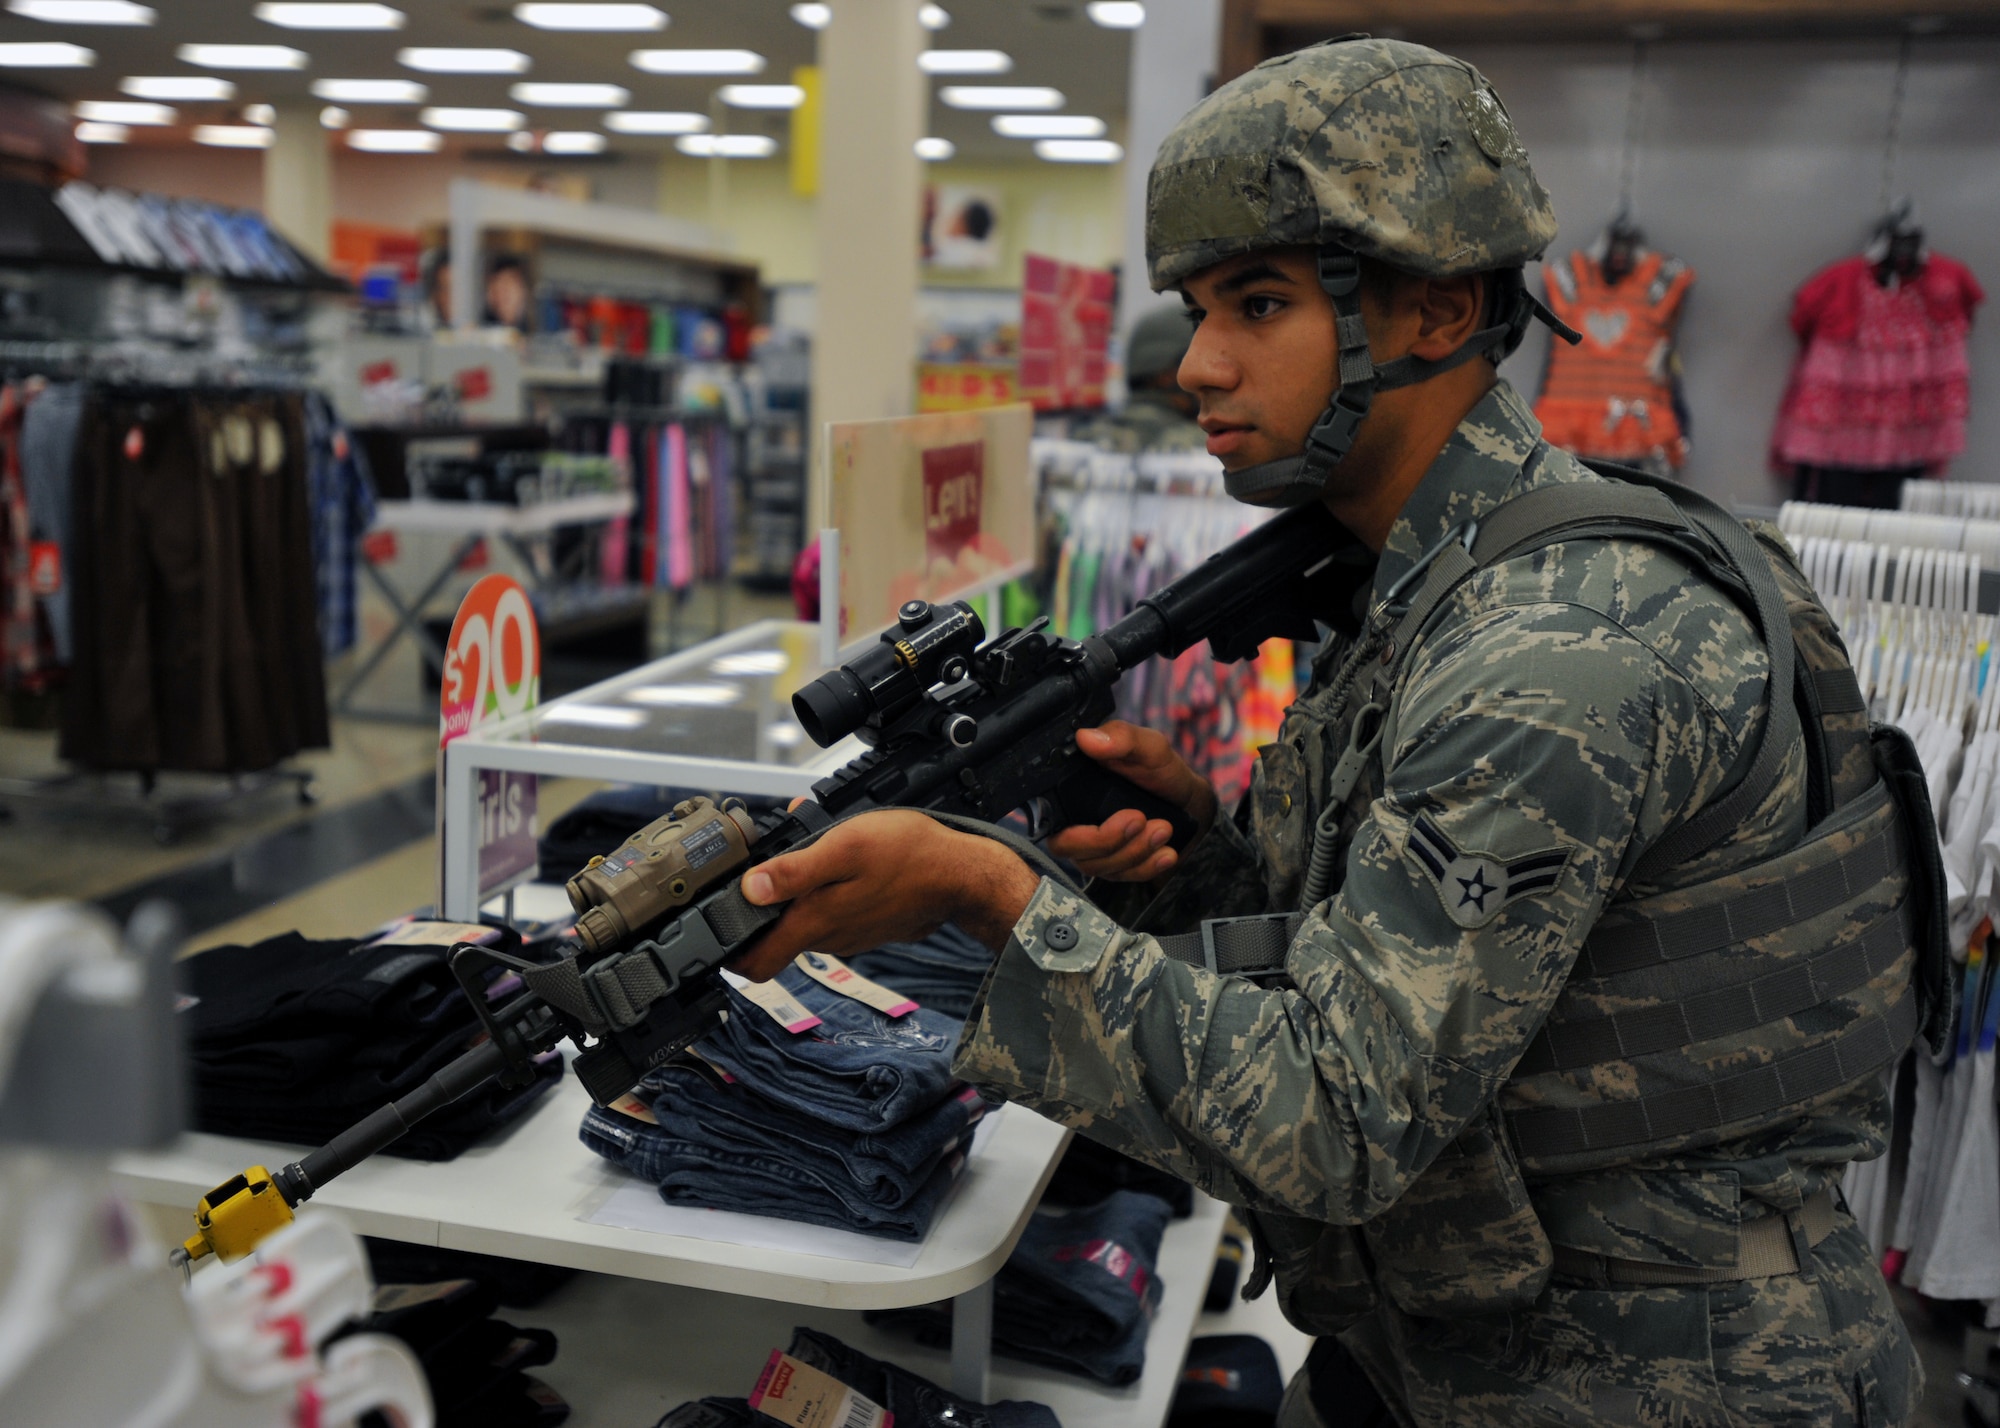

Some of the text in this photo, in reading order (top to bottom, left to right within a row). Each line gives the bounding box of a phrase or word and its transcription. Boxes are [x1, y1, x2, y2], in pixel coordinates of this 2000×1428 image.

[448, 705, 471, 731] only
[478, 770, 522, 848] irls
[796, 1399, 814, 1425] Flare
